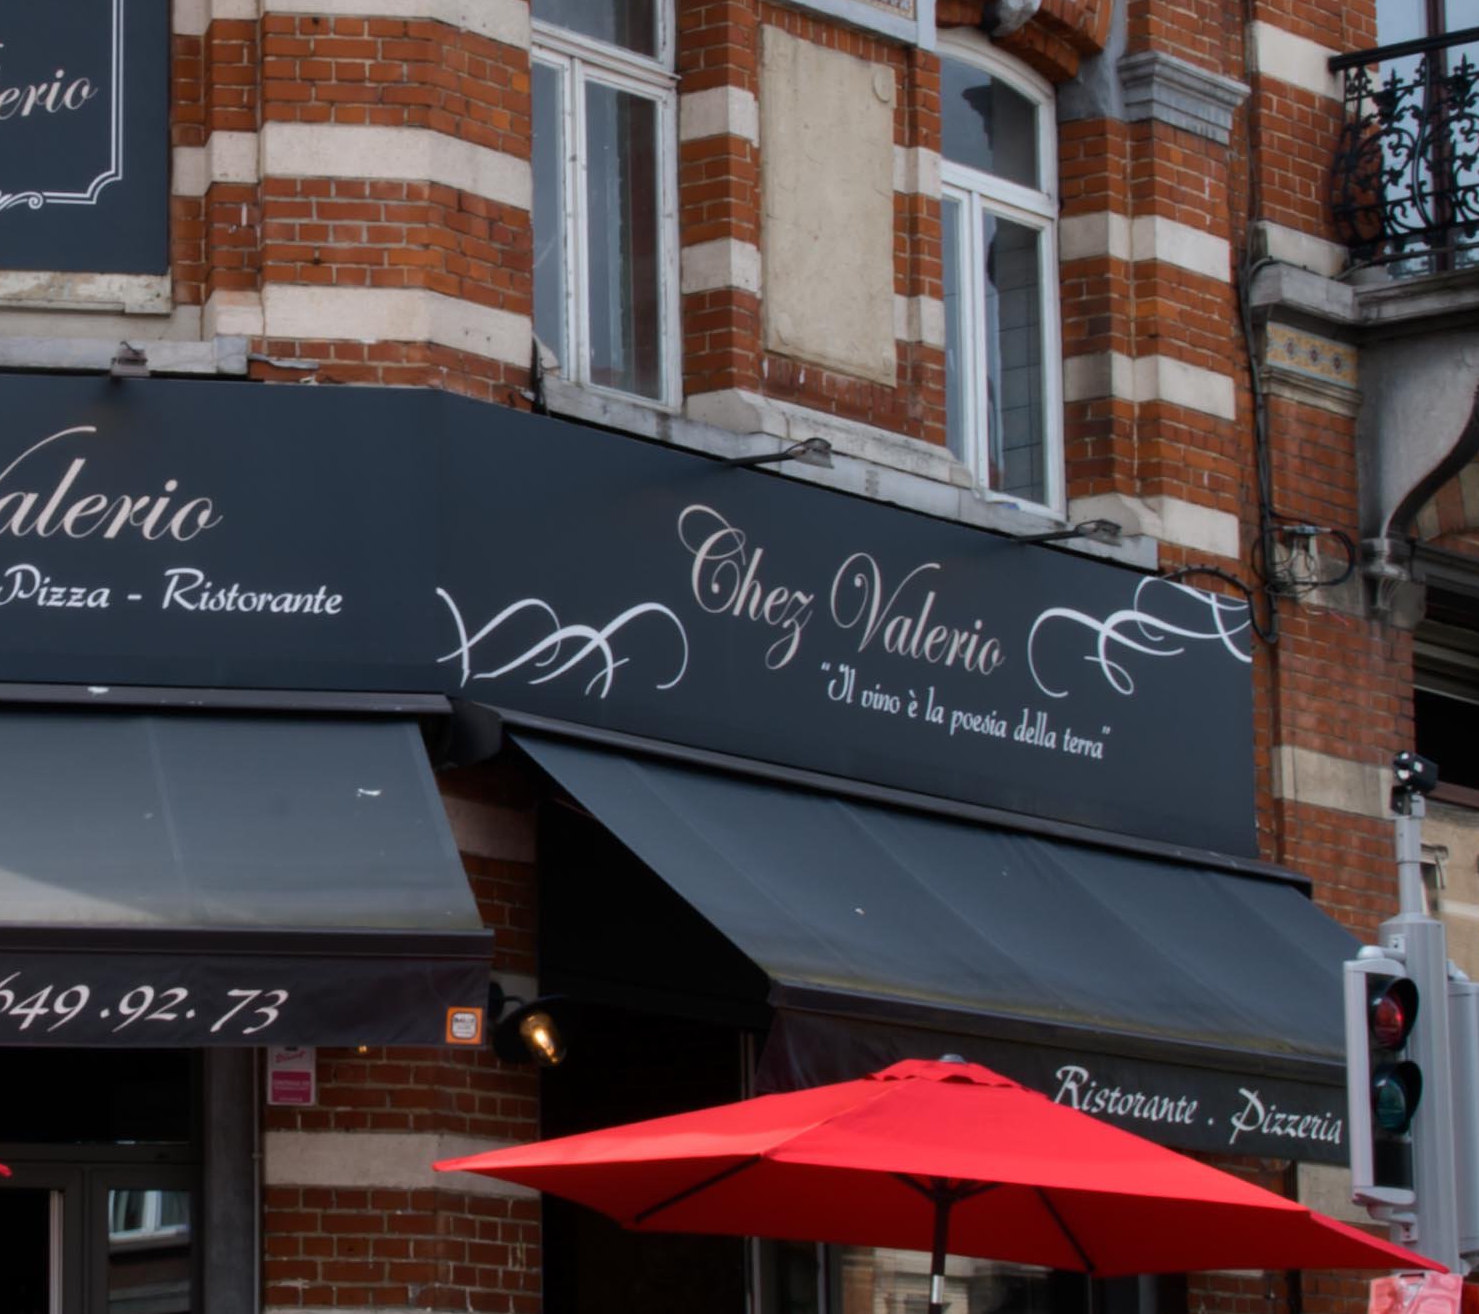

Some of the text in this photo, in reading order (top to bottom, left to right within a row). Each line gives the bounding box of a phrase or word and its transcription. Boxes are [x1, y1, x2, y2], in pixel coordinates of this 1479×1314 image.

[161, 567, 343, 615] Ristorante
[677, 503, 1005, 676] Chez Valerio
[860, 683, 902, 715] vino
[907, 688, 919, 719] è
[924, 685, 945, 725] la
[949, 709, 1008, 739] poesia
[1013, 707, 1058, 750] della
[1054, 1065, 1198, 1125] Ristorante
[1230, 1087, 1343, 1145] Pizzeria
